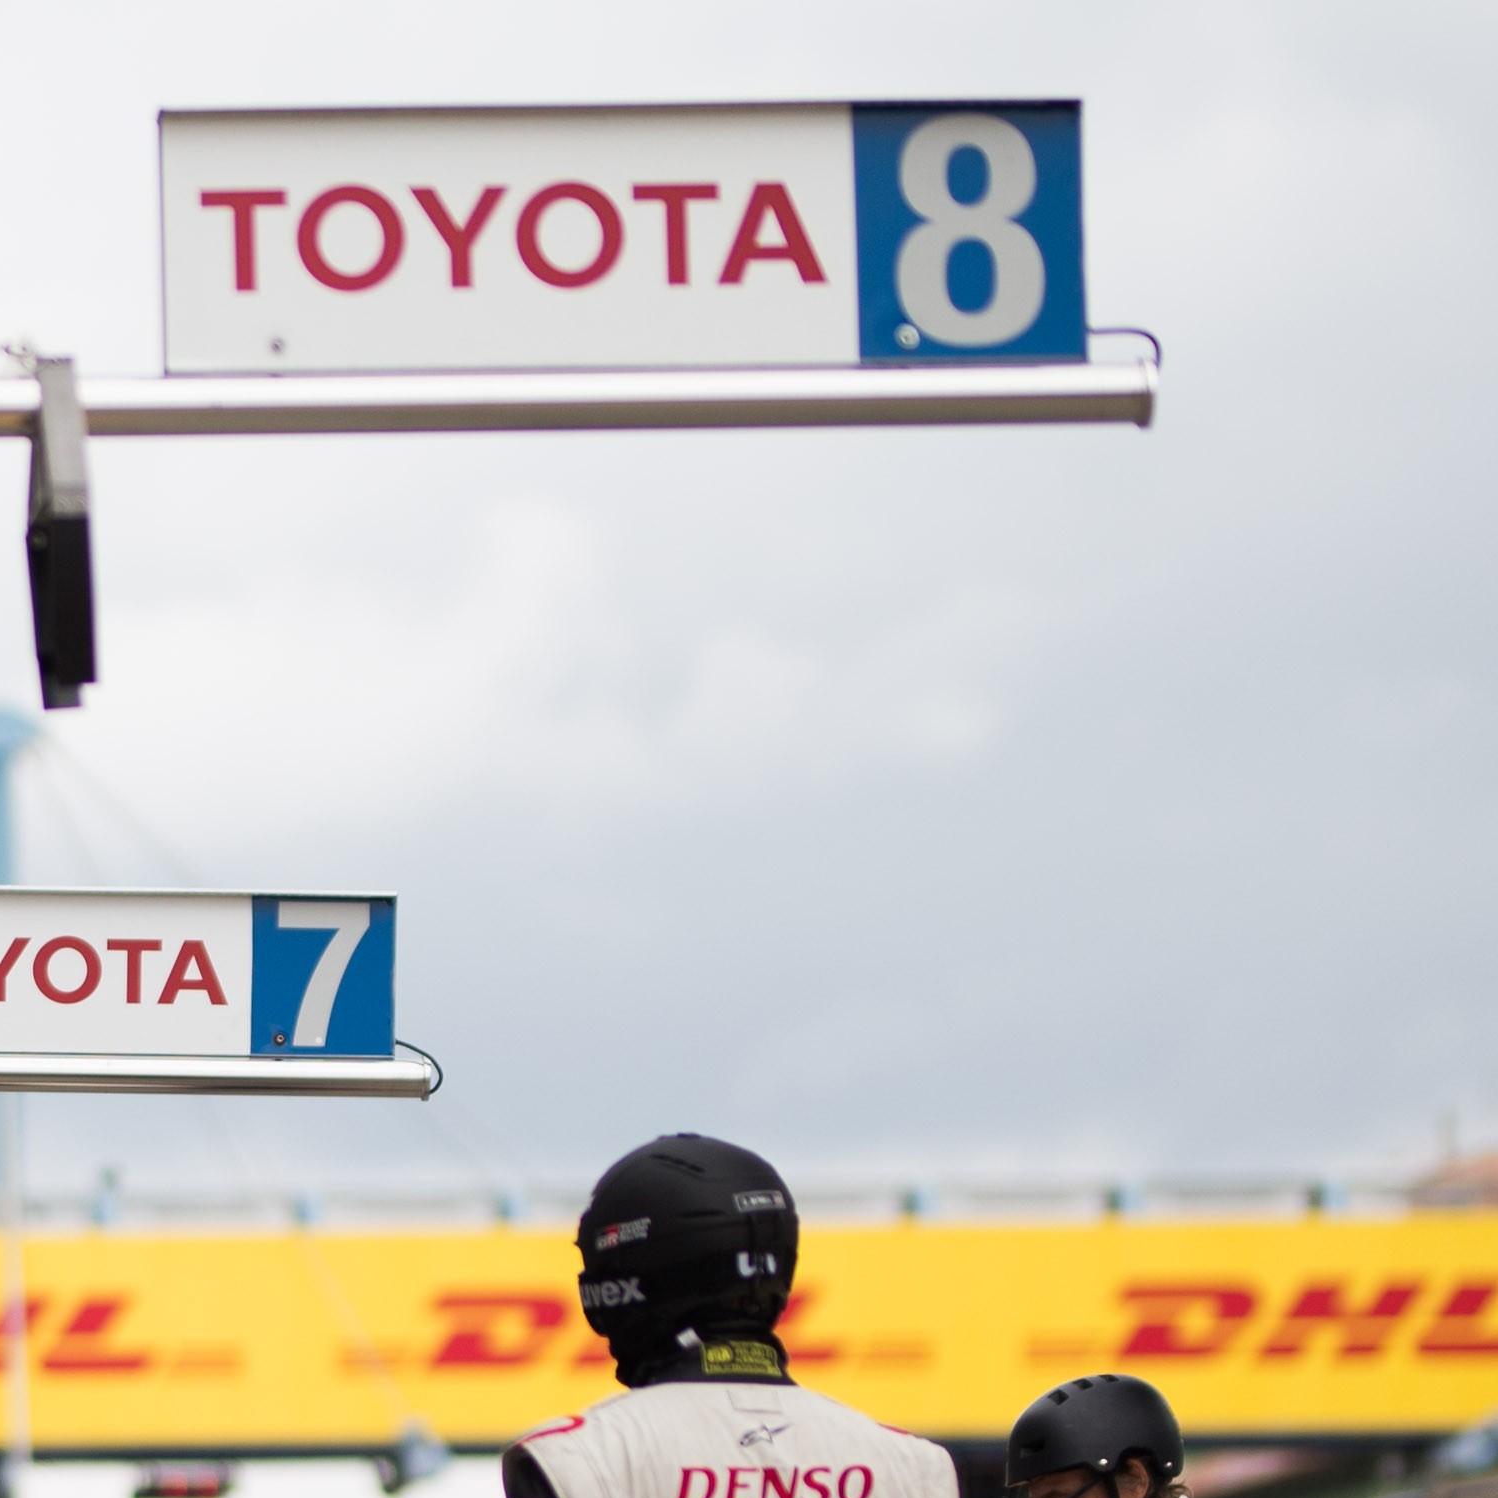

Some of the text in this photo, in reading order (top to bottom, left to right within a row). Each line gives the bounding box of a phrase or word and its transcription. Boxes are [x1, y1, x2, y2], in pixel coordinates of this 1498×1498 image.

[199, 112, 1047, 348] TOYOTA 8
[276, 901, 371, 1047] 7
